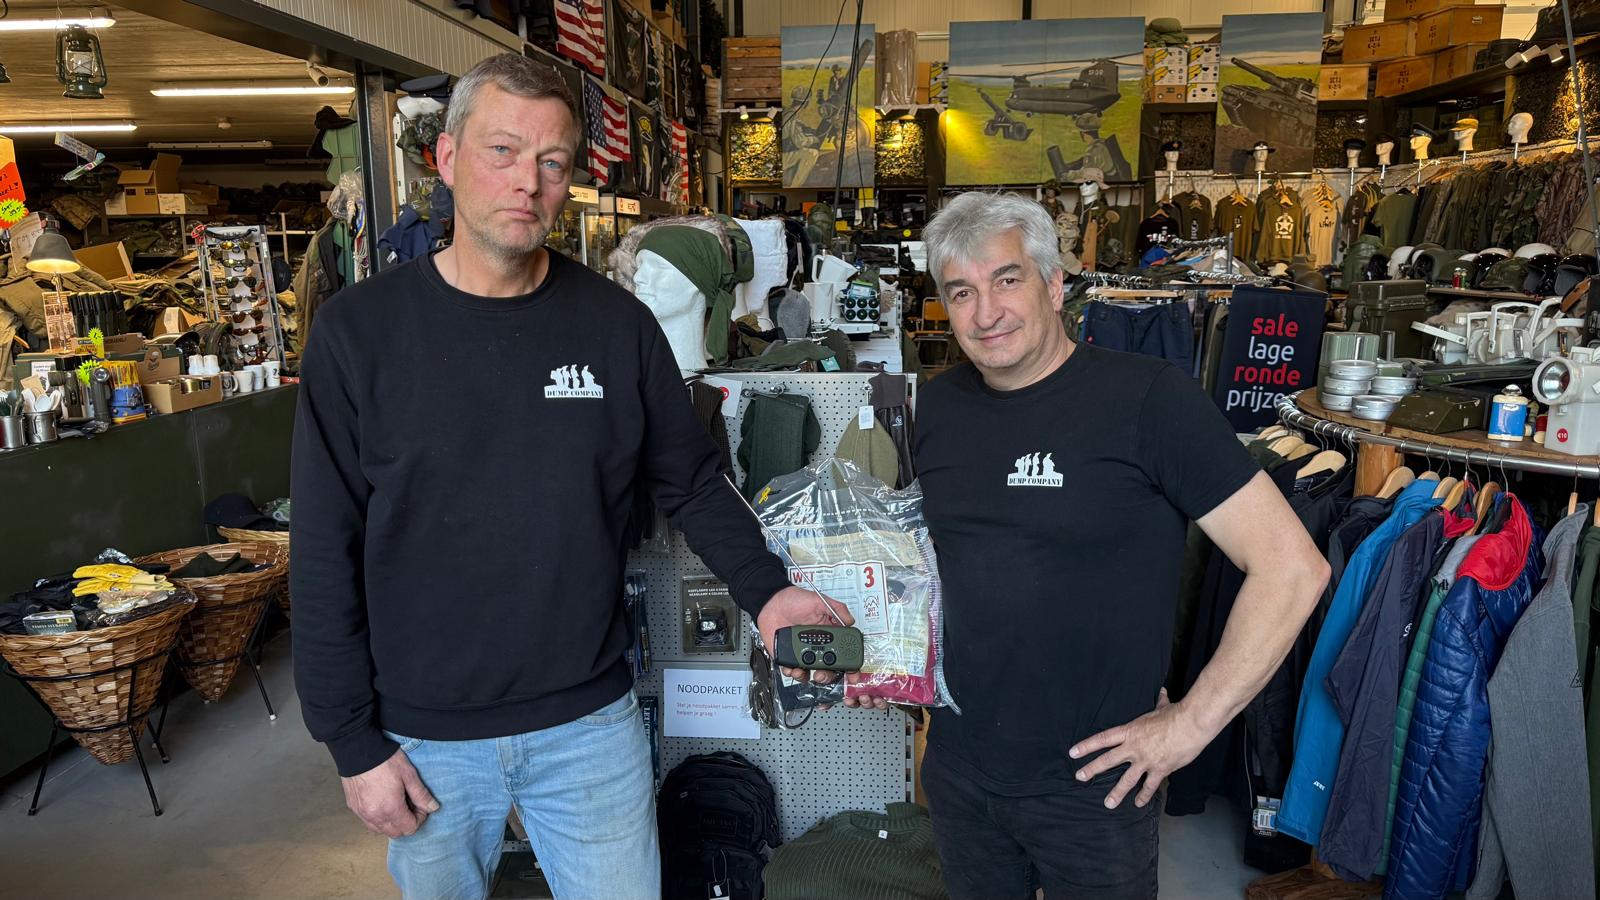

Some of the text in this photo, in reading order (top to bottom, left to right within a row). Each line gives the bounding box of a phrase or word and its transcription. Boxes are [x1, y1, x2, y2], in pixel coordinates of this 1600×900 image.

[1251, 313, 1299, 337] sale
[1248, 336, 1295, 365] lage
[1234, 363, 1301, 386] ronde
[1226, 385, 1285, 413] prijze
[863, 566, 875, 588] 3
[677, 684, 743, 695] NOODPAKKET
[692, 702, 720, 710] noodpakket
